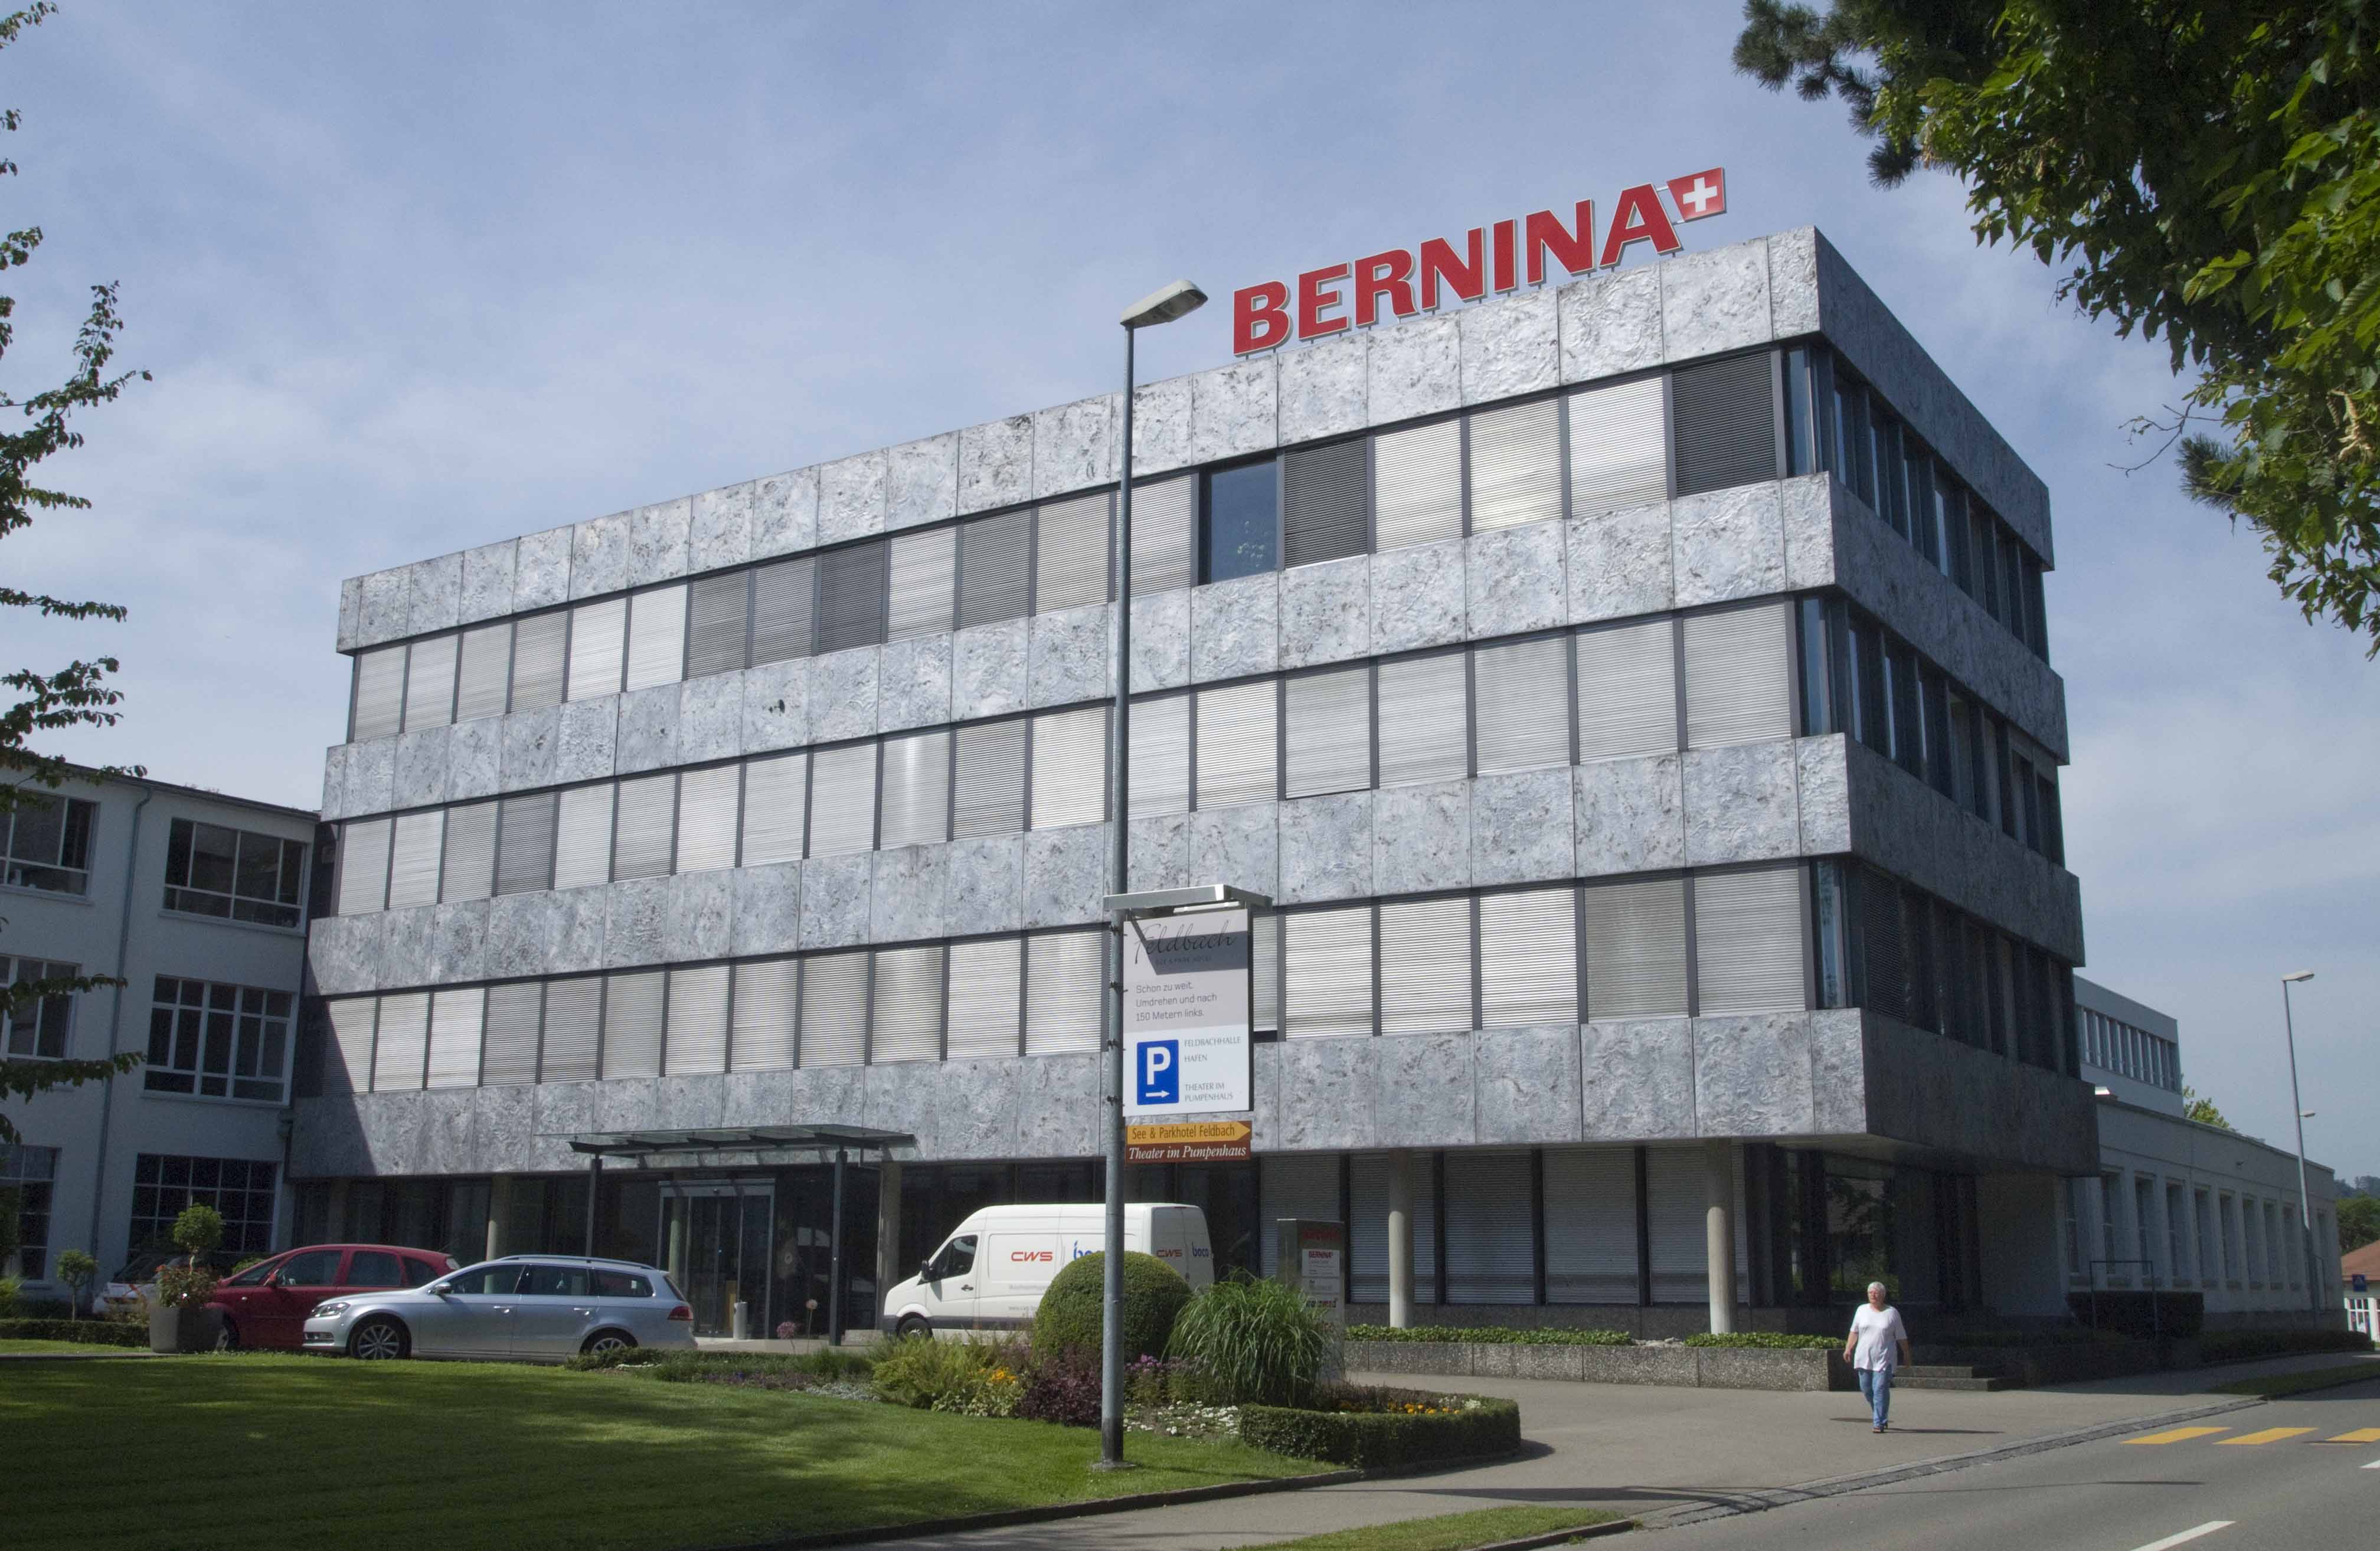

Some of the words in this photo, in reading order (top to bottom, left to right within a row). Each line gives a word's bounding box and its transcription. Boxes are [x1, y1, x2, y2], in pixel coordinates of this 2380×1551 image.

[1232, 182, 1683, 357] BERNINA
[1134, 920, 1237, 964] Feldbach
[1136, 984, 1161, 994] Schon
[1136, 997, 1177, 1007] Umdrehen
[1179, 994, 1195, 1004] und
[1197, 993, 1217, 1002] nach
[1136, 1012, 1150, 1022] 150
[1152, 1011, 1182, 1020] Metern
[1184, 1036, 1241, 1047] FELDBACHHALLE
[1184, 1054, 1208, 1062] HAFEN
[1147, 1046, 1171, 1085] P
[1185, 1082, 1214, 1091] THEATER
[1185, 1092, 1233, 1102] PUMPENHAUS
[1132, 1128, 1146, 1139] See
[1150, 1127, 1156, 1138] &
[1159, 1125, 1196, 1138] Parkhotel
[1199, 1124, 1235, 1137] Feldbach
[1129, 1147, 1165, 1160] Theater
[1167, 1146, 1180, 1158] im
[1182, 1144, 1246, 1160] Pumpenhaus
[1011, 1251, 1053, 1262] CWS
[1156, 1249, 1182, 1257] CWS
